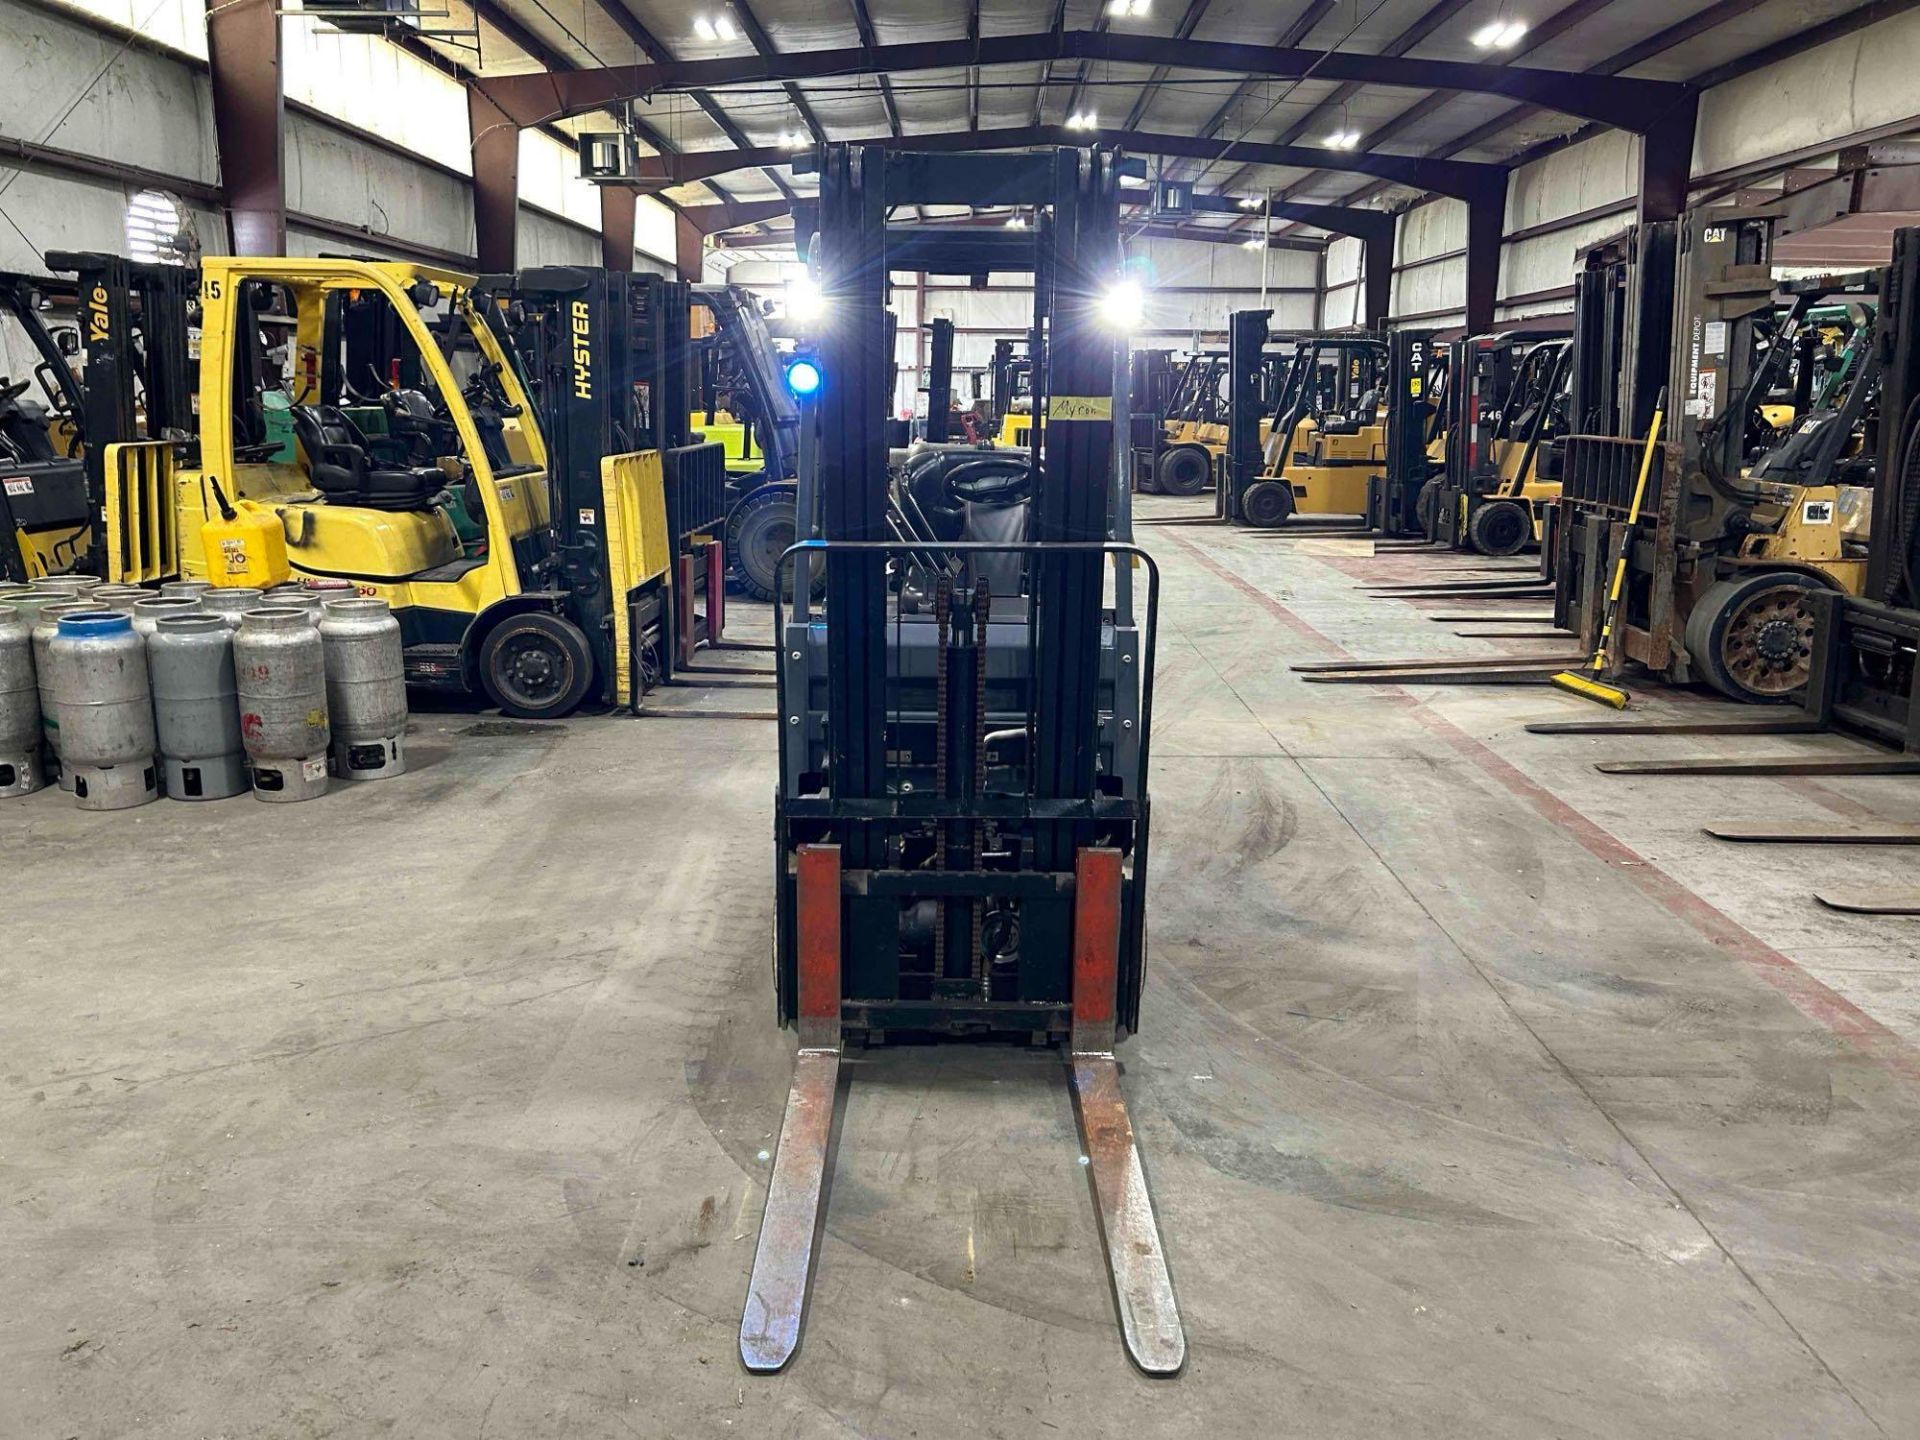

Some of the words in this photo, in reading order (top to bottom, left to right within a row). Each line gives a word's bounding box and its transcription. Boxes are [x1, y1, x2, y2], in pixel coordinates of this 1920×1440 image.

[1704, 227, 1727, 242] CAT
[90, 286, 110, 342] Yale
[1693, 315, 1701, 340] DEPOT
[572, 301, 592, 399] HYSTER
[1411, 342, 1423, 372] CAT
[1351, 359, 1360, 379] Yale
[1690, 343, 1700, 394] EQUIPMENT
